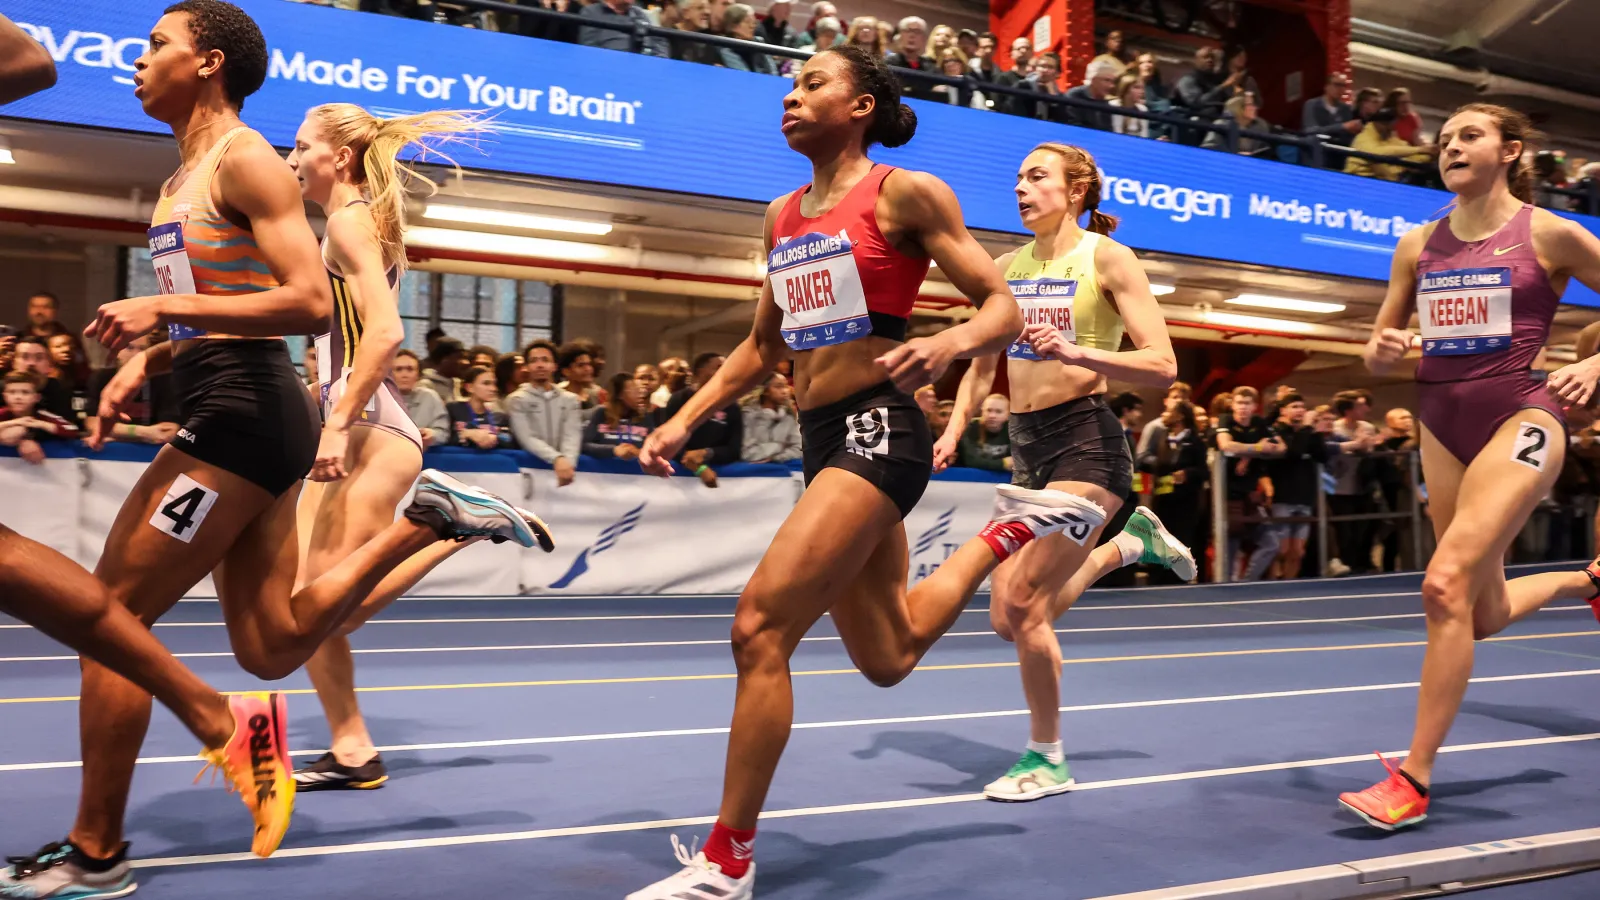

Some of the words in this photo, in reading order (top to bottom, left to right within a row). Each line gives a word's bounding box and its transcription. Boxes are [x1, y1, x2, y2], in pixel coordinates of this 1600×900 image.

[268, 48, 389, 92] Made
[396, 65, 459, 100] For
[462, 73, 544, 112] Your
[1097, 167, 1232, 222] revagen
[1249, 193, 1313, 224] Made
[1314, 203, 1348, 228] For
[1348, 208, 1392, 236] Your
[772, 244, 808, 268] MILLROSE
[809, 237, 842, 257] GAMES
[786, 269, 836, 314] BAKER
[1040, 285, 1070, 295] GAMES
[1462, 274, 1502, 286] GAMES
[1429, 296, 1489, 327] KEEGAN
[1516, 426, 1546, 467] 2
[161, 486, 207, 536] 4
[248, 713, 277, 808] NITRO
